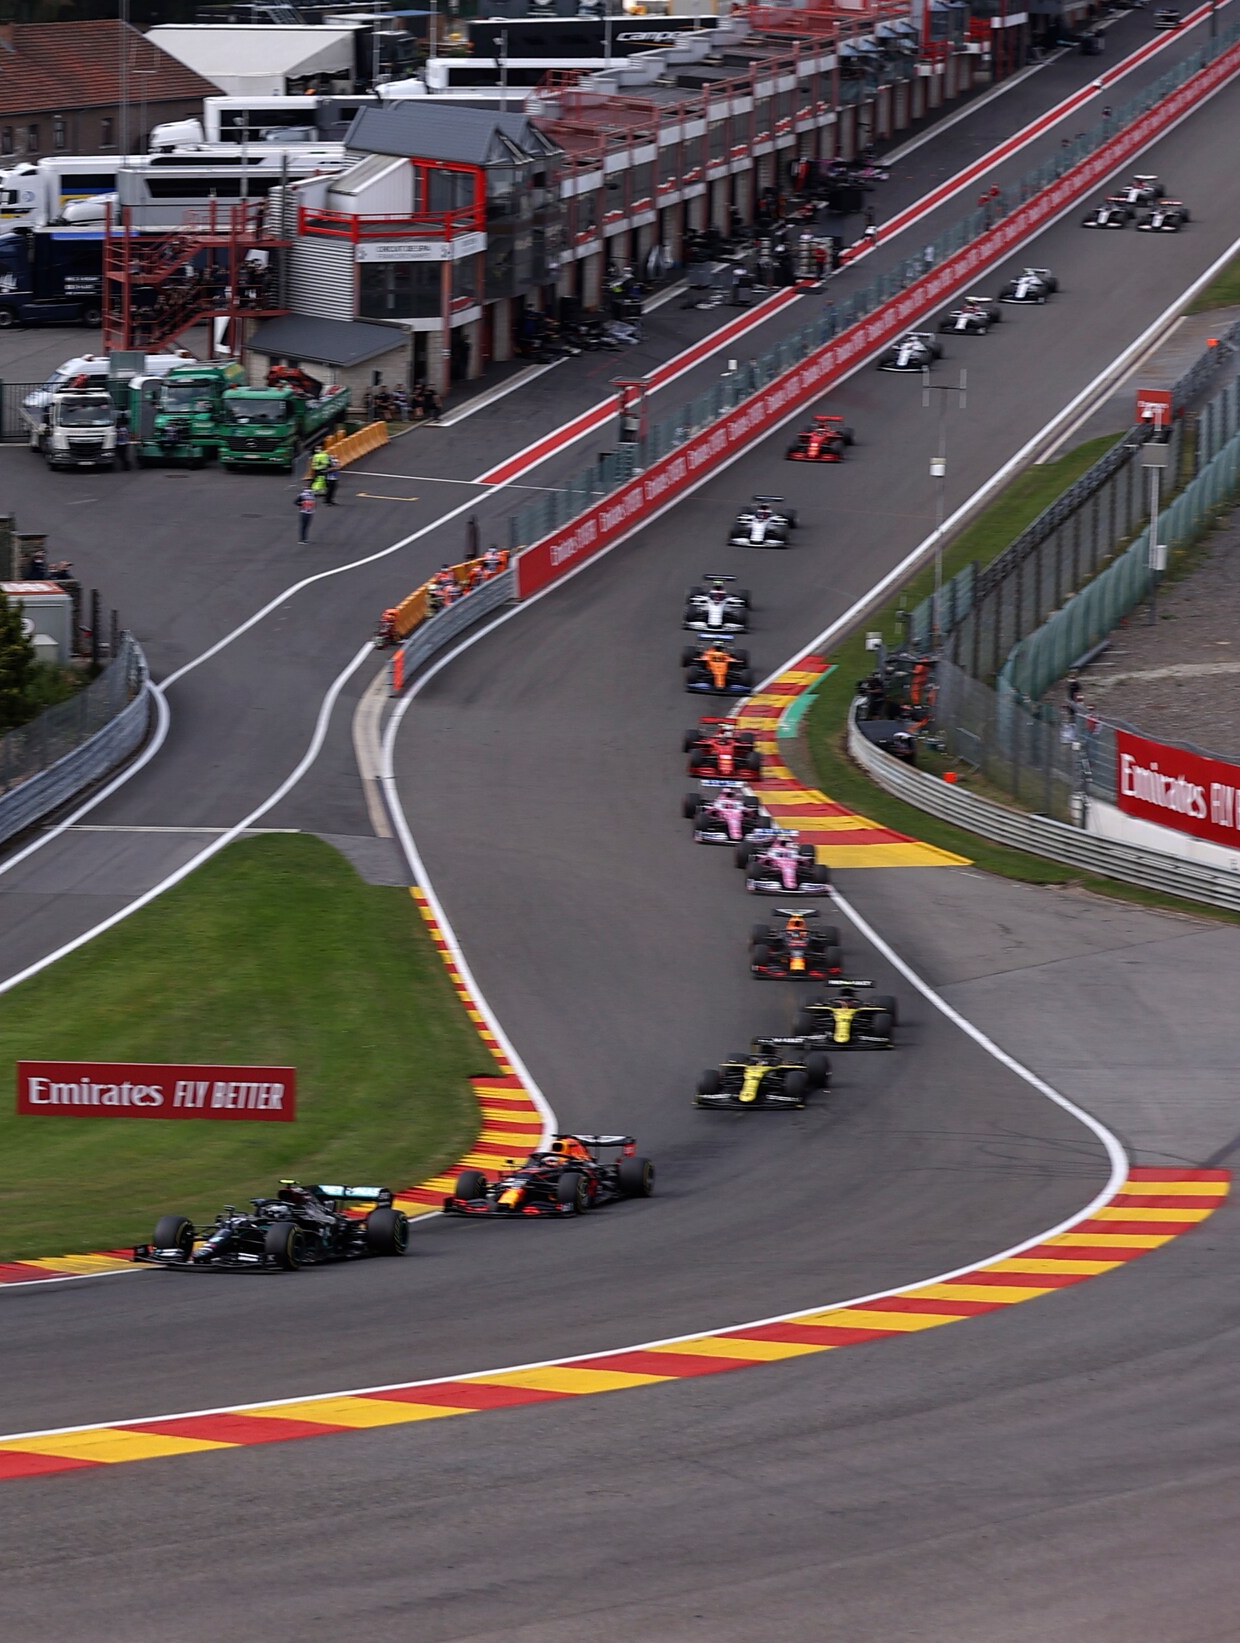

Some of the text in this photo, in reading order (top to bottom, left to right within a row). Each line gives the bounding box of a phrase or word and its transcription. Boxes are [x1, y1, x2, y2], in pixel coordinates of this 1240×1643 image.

[616, 31, 684, 42] campo
[1120, 753, 1208, 819] Emirates
[27, 1077, 285, 1110] Emirates FLY BETTER
